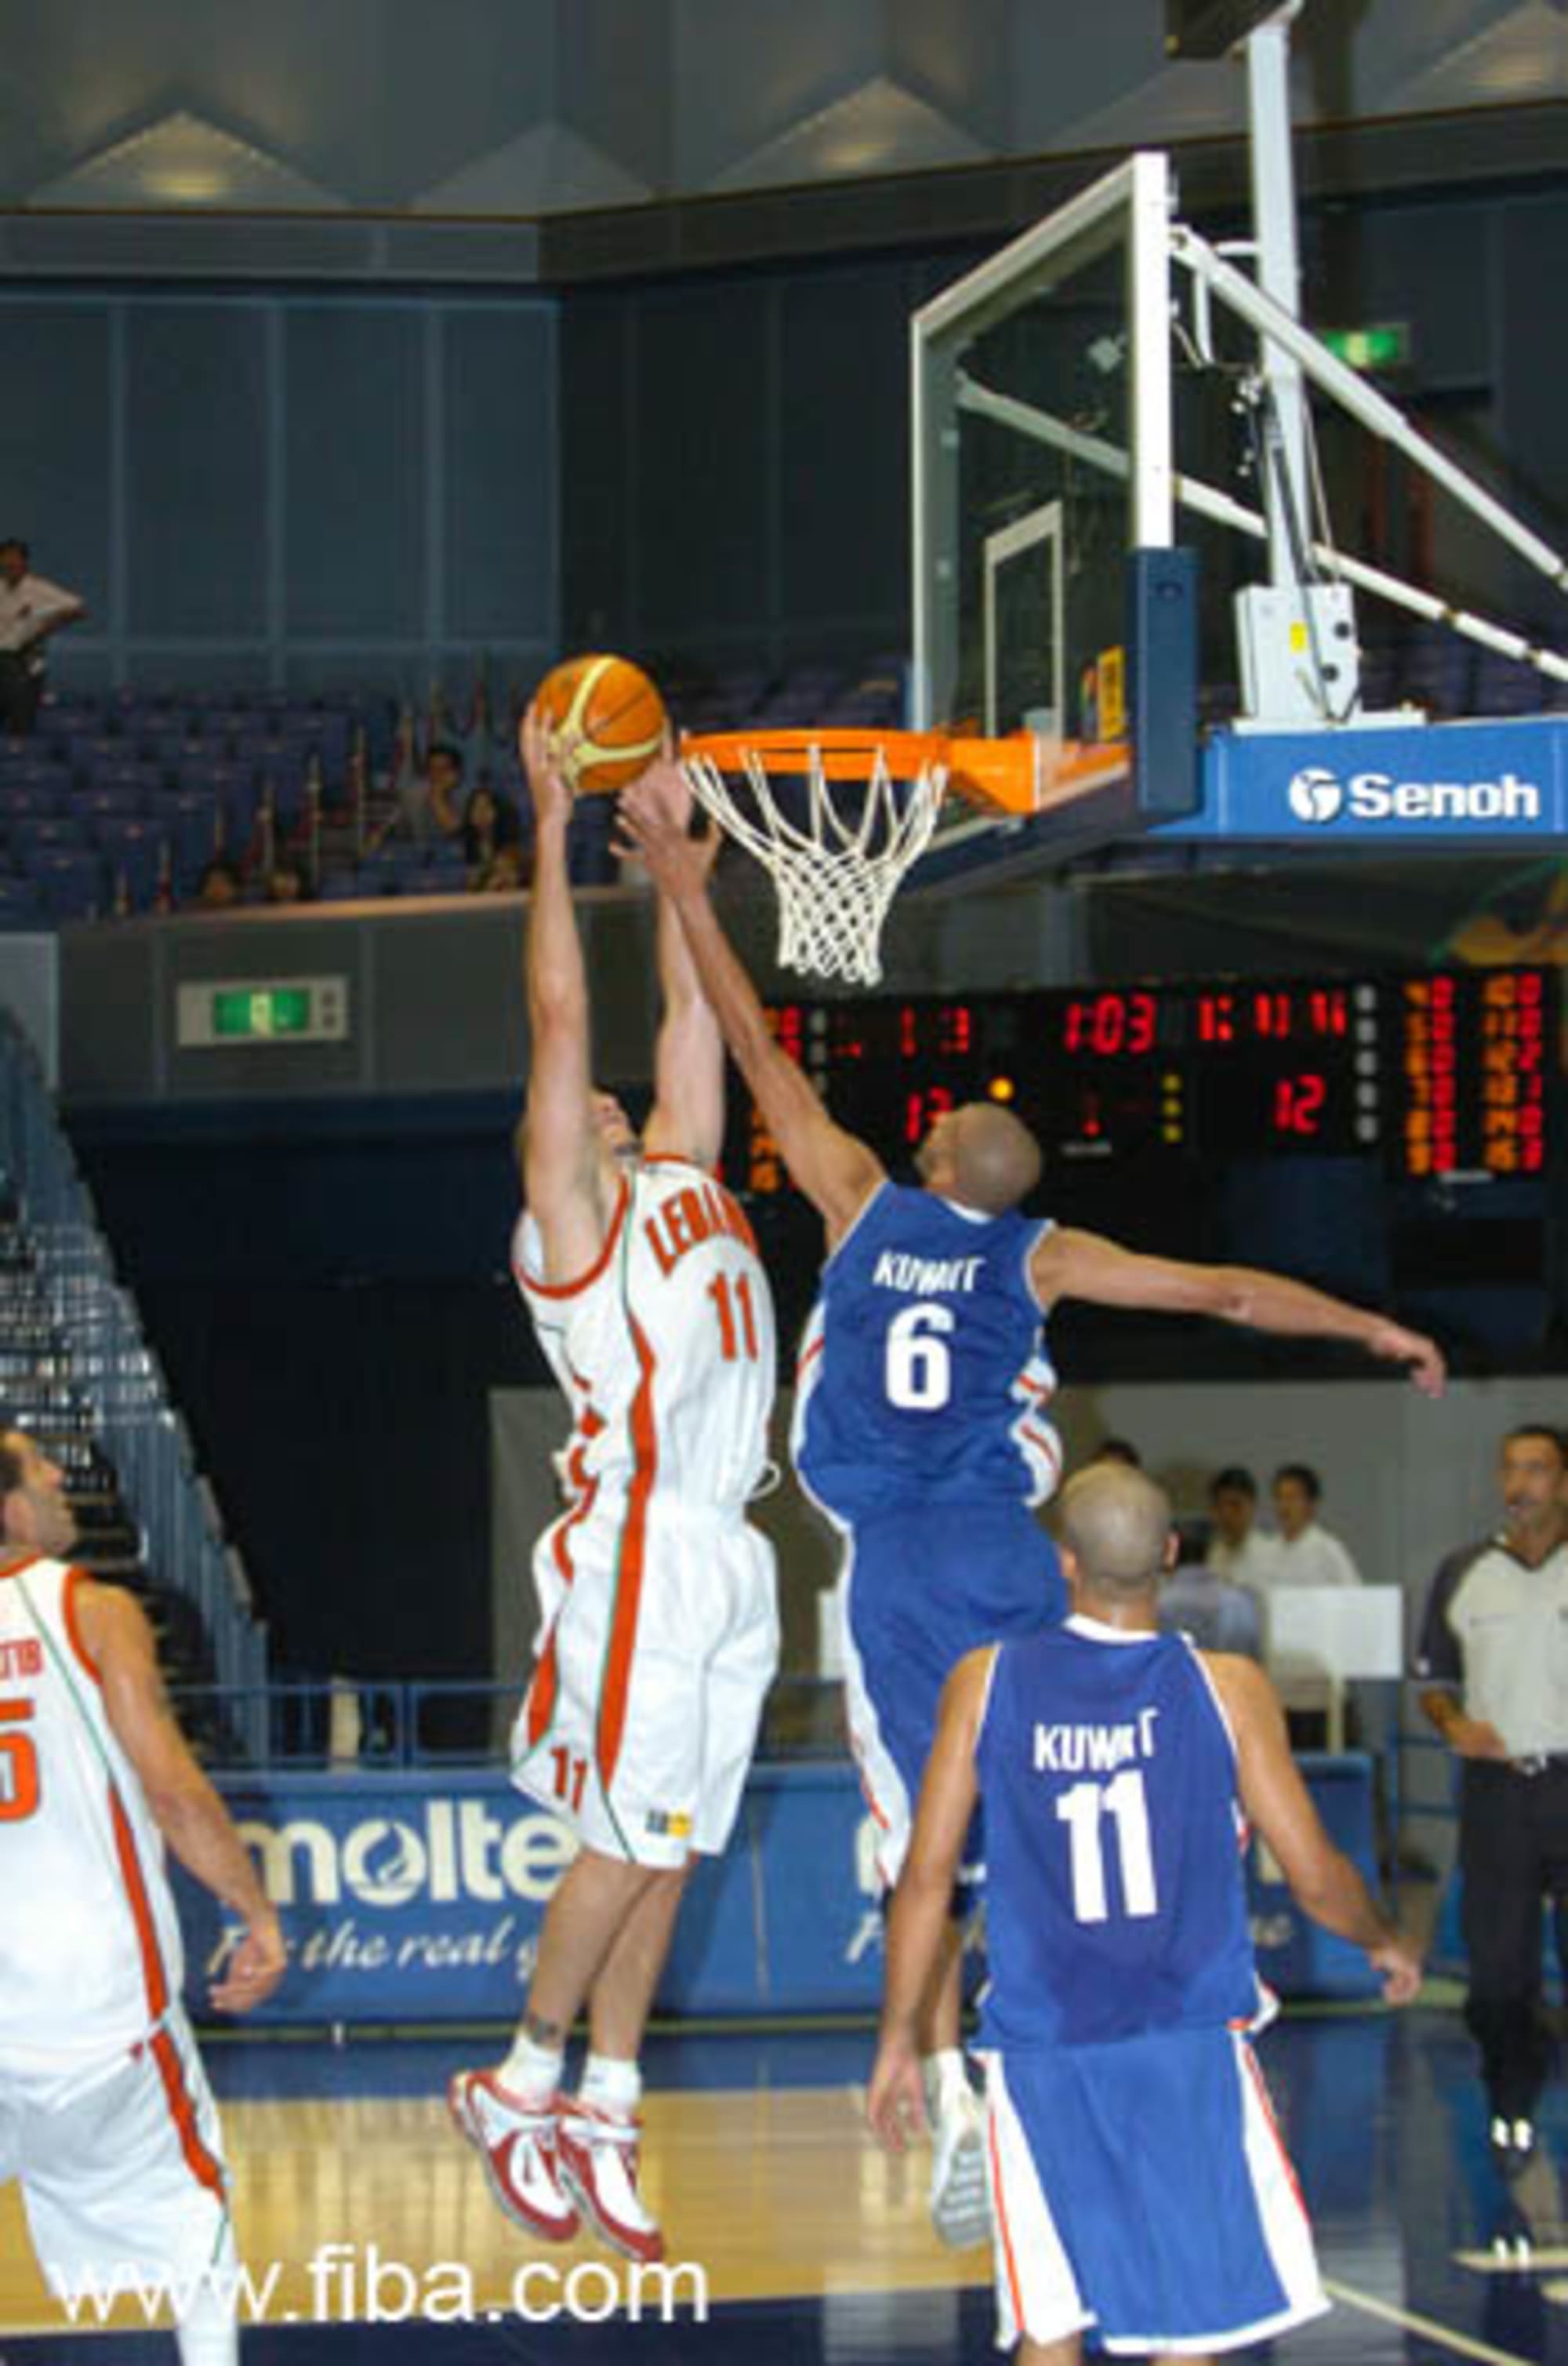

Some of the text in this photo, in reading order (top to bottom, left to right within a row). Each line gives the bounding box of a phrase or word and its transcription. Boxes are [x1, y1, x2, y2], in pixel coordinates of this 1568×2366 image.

[1348, 772, 1540, 819] Senoh
[1064, 994, 1155, 1053] 1:03
[1274, 1073, 1325, 1134] 12
[707, 1270, 759, 1363] 11
[887, 1302, 955, 1410] 6
[550, 1746, 587, 1815] 11
[1056, 1769, 1158, 1923] 11
[398, 1915, 516, 1969] real
